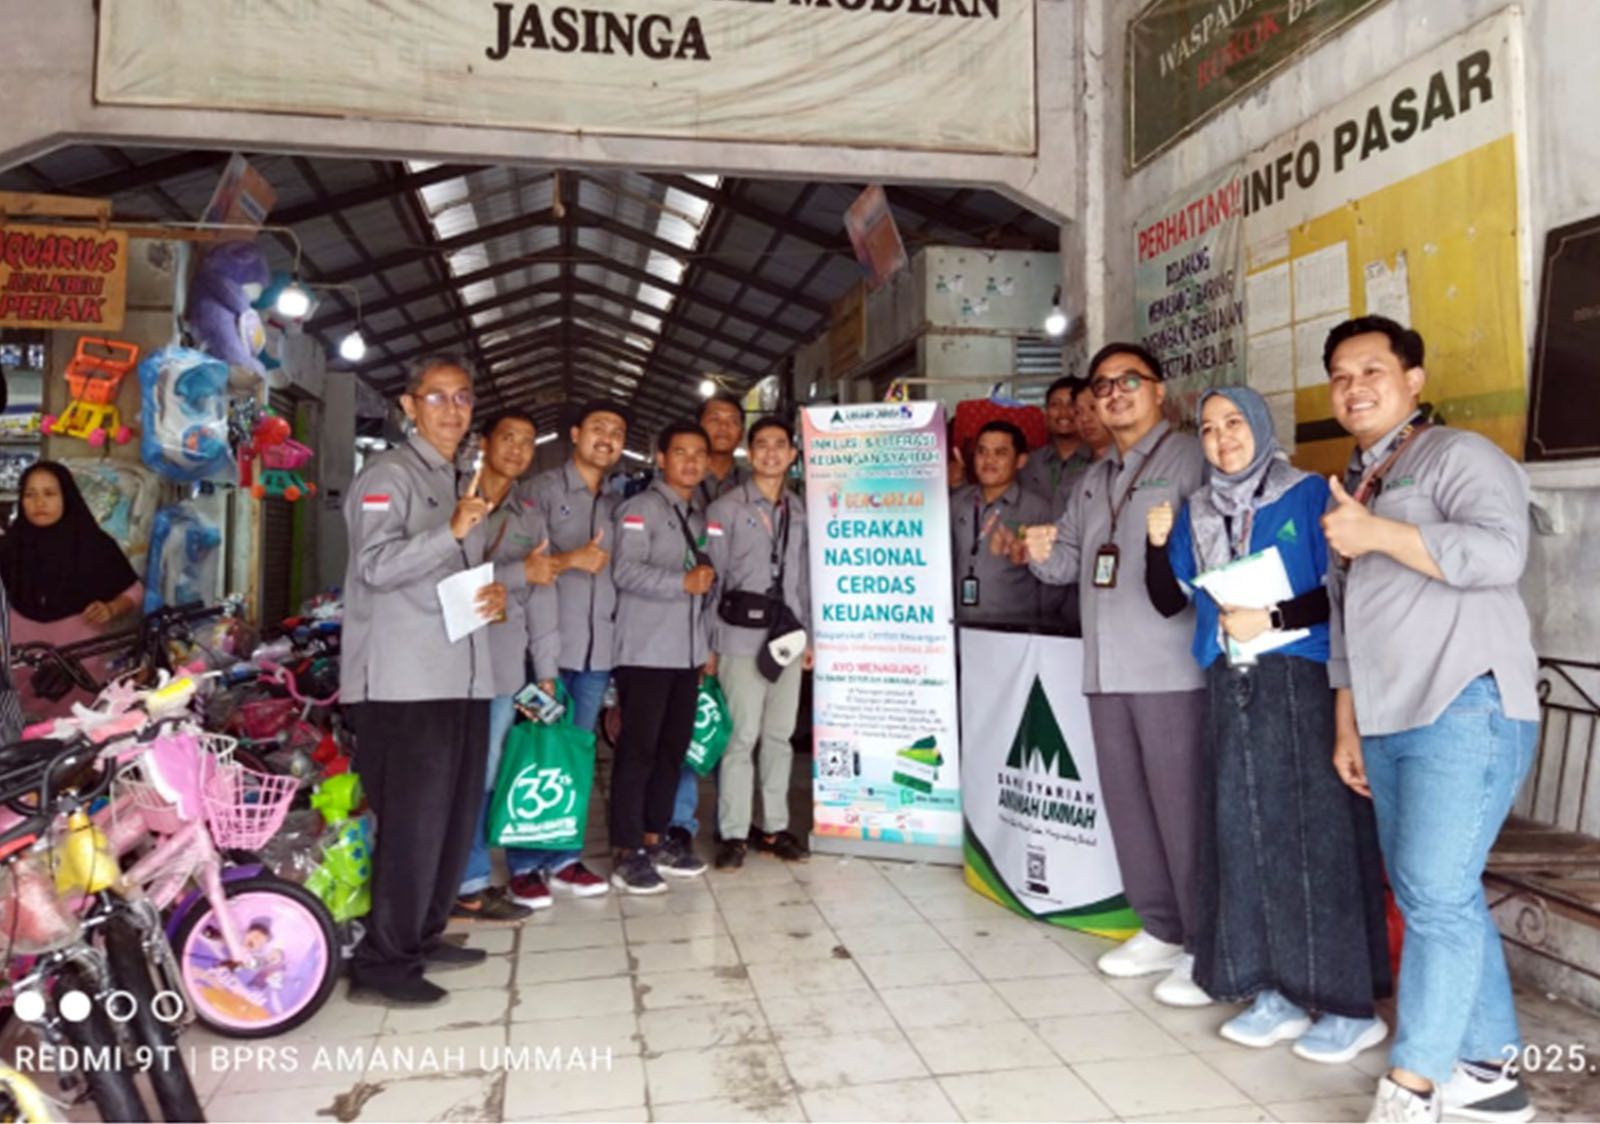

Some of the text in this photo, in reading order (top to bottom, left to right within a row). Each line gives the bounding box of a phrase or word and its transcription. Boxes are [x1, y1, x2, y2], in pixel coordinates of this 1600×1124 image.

[789, 0, 999, 19] ERN
[486, 3, 711, 60] JASINGA
[1242, 49, 1494, 219] INFO PASAR
[0, 229, 118, 273] QUARIUS
[0, 294, 106, 323] PERAK
[826, 519, 924, 539] GERAKAN
[824, 548, 927, 567] NASIONAL
[837, 575, 916, 595] CERDAS
[822, 604, 934, 624] KEUANGAN
